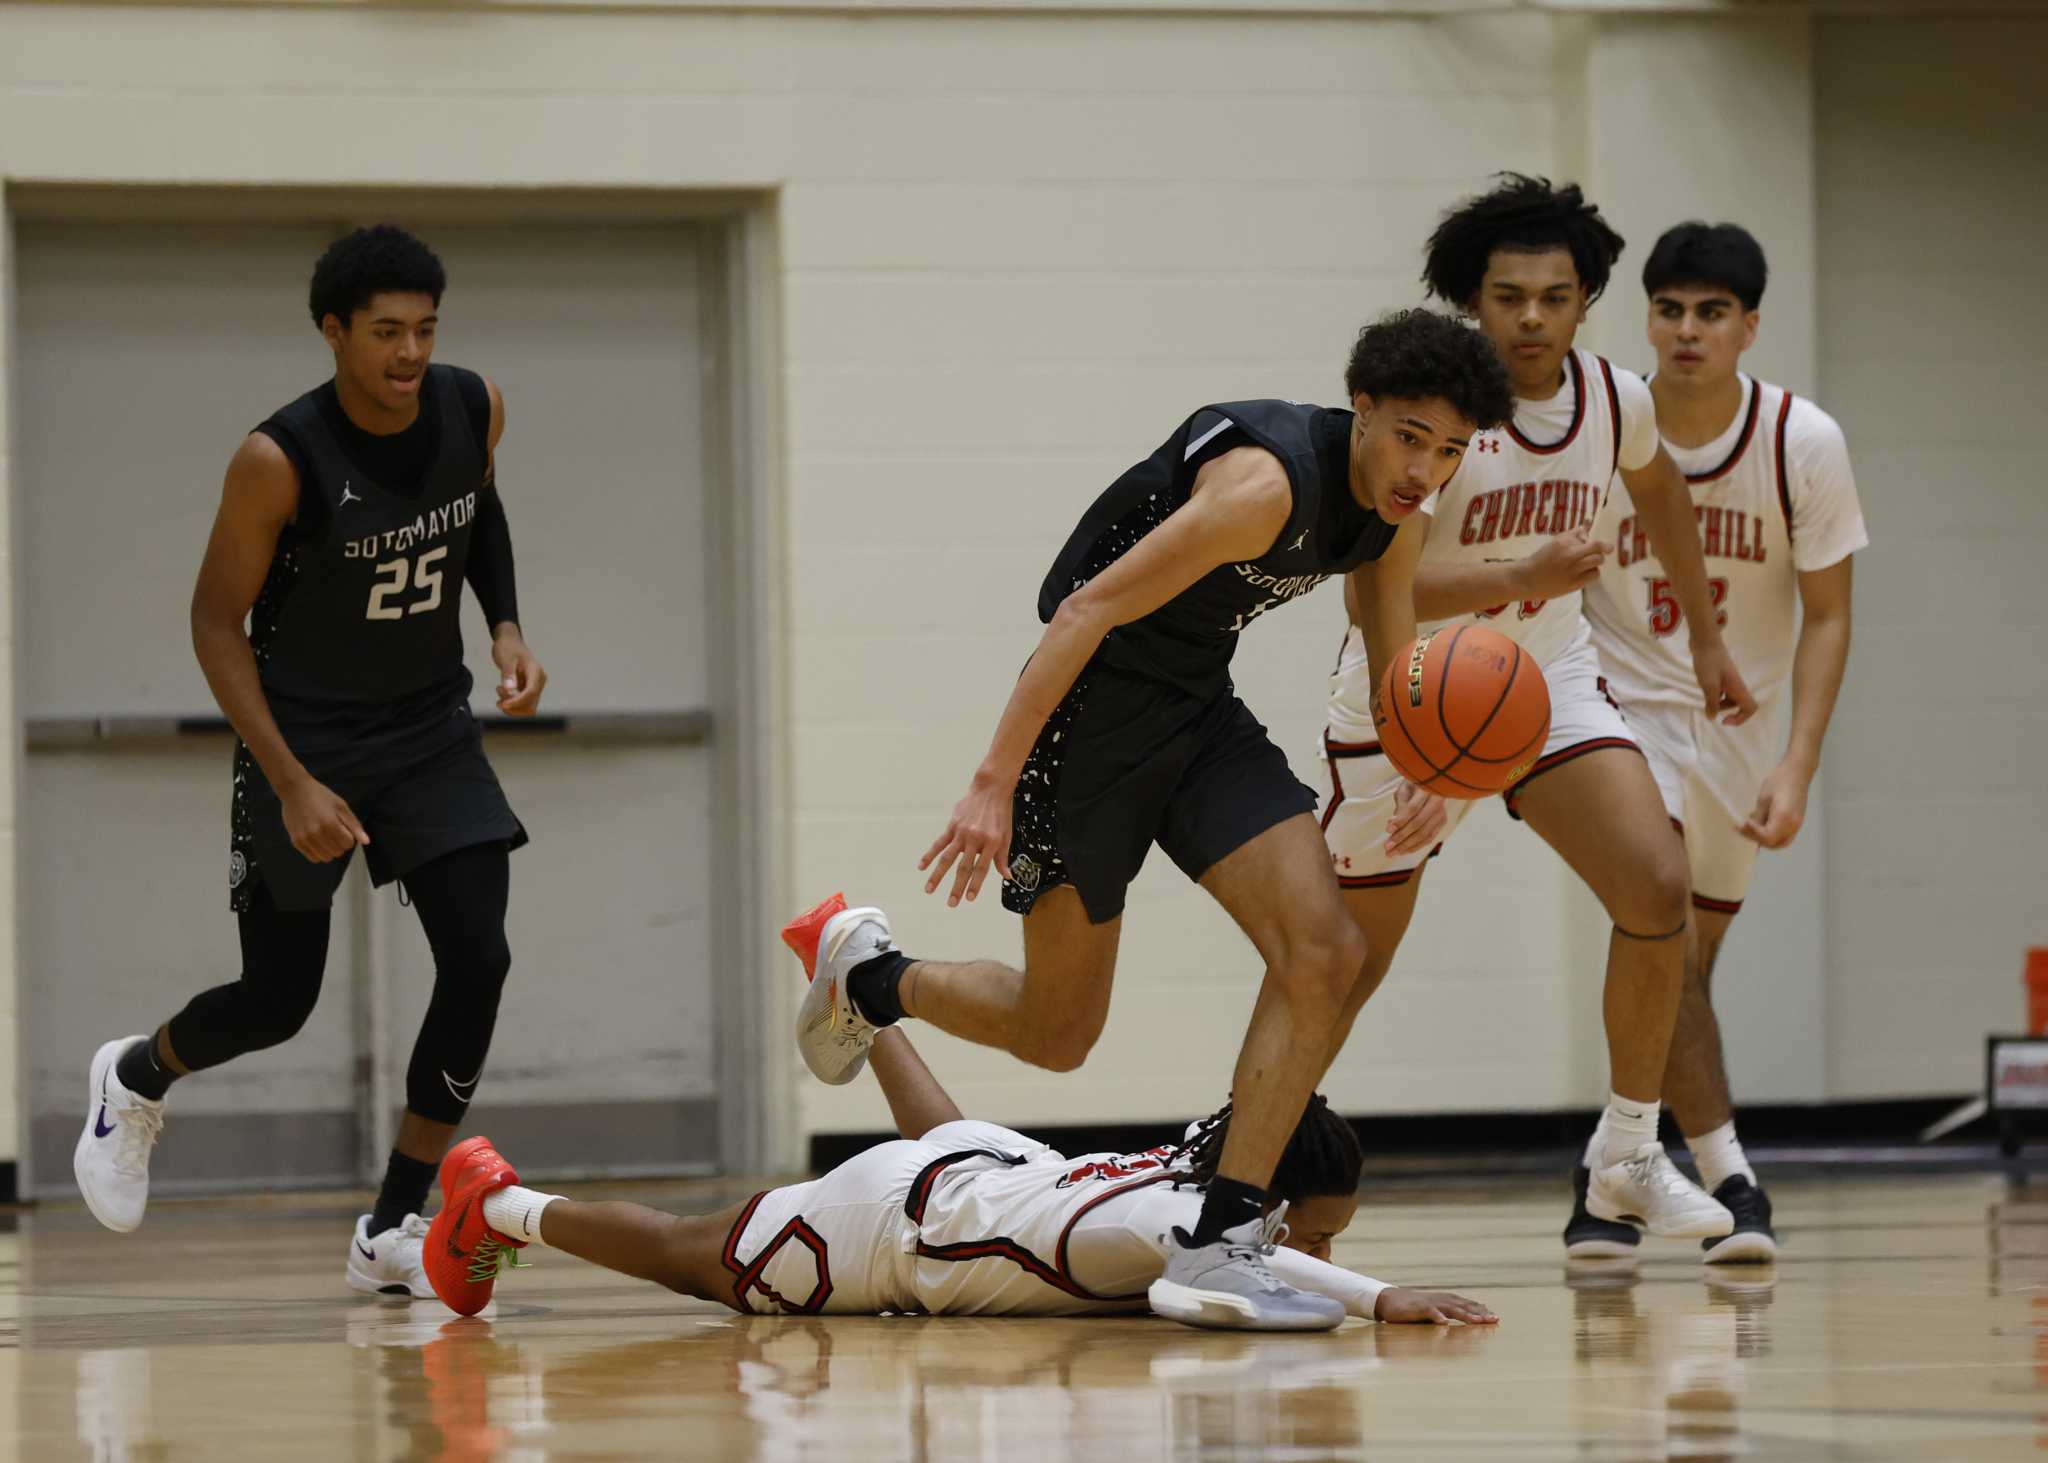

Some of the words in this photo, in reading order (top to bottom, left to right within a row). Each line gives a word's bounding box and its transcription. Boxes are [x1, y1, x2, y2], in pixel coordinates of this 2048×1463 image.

[344, 491, 476, 558] SOTOMAYOR
[1459, 480, 1601, 546] CHURCHILL
[1618, 505, 1767, 568] CHHILL
[366, 545, 448, 620] 25
